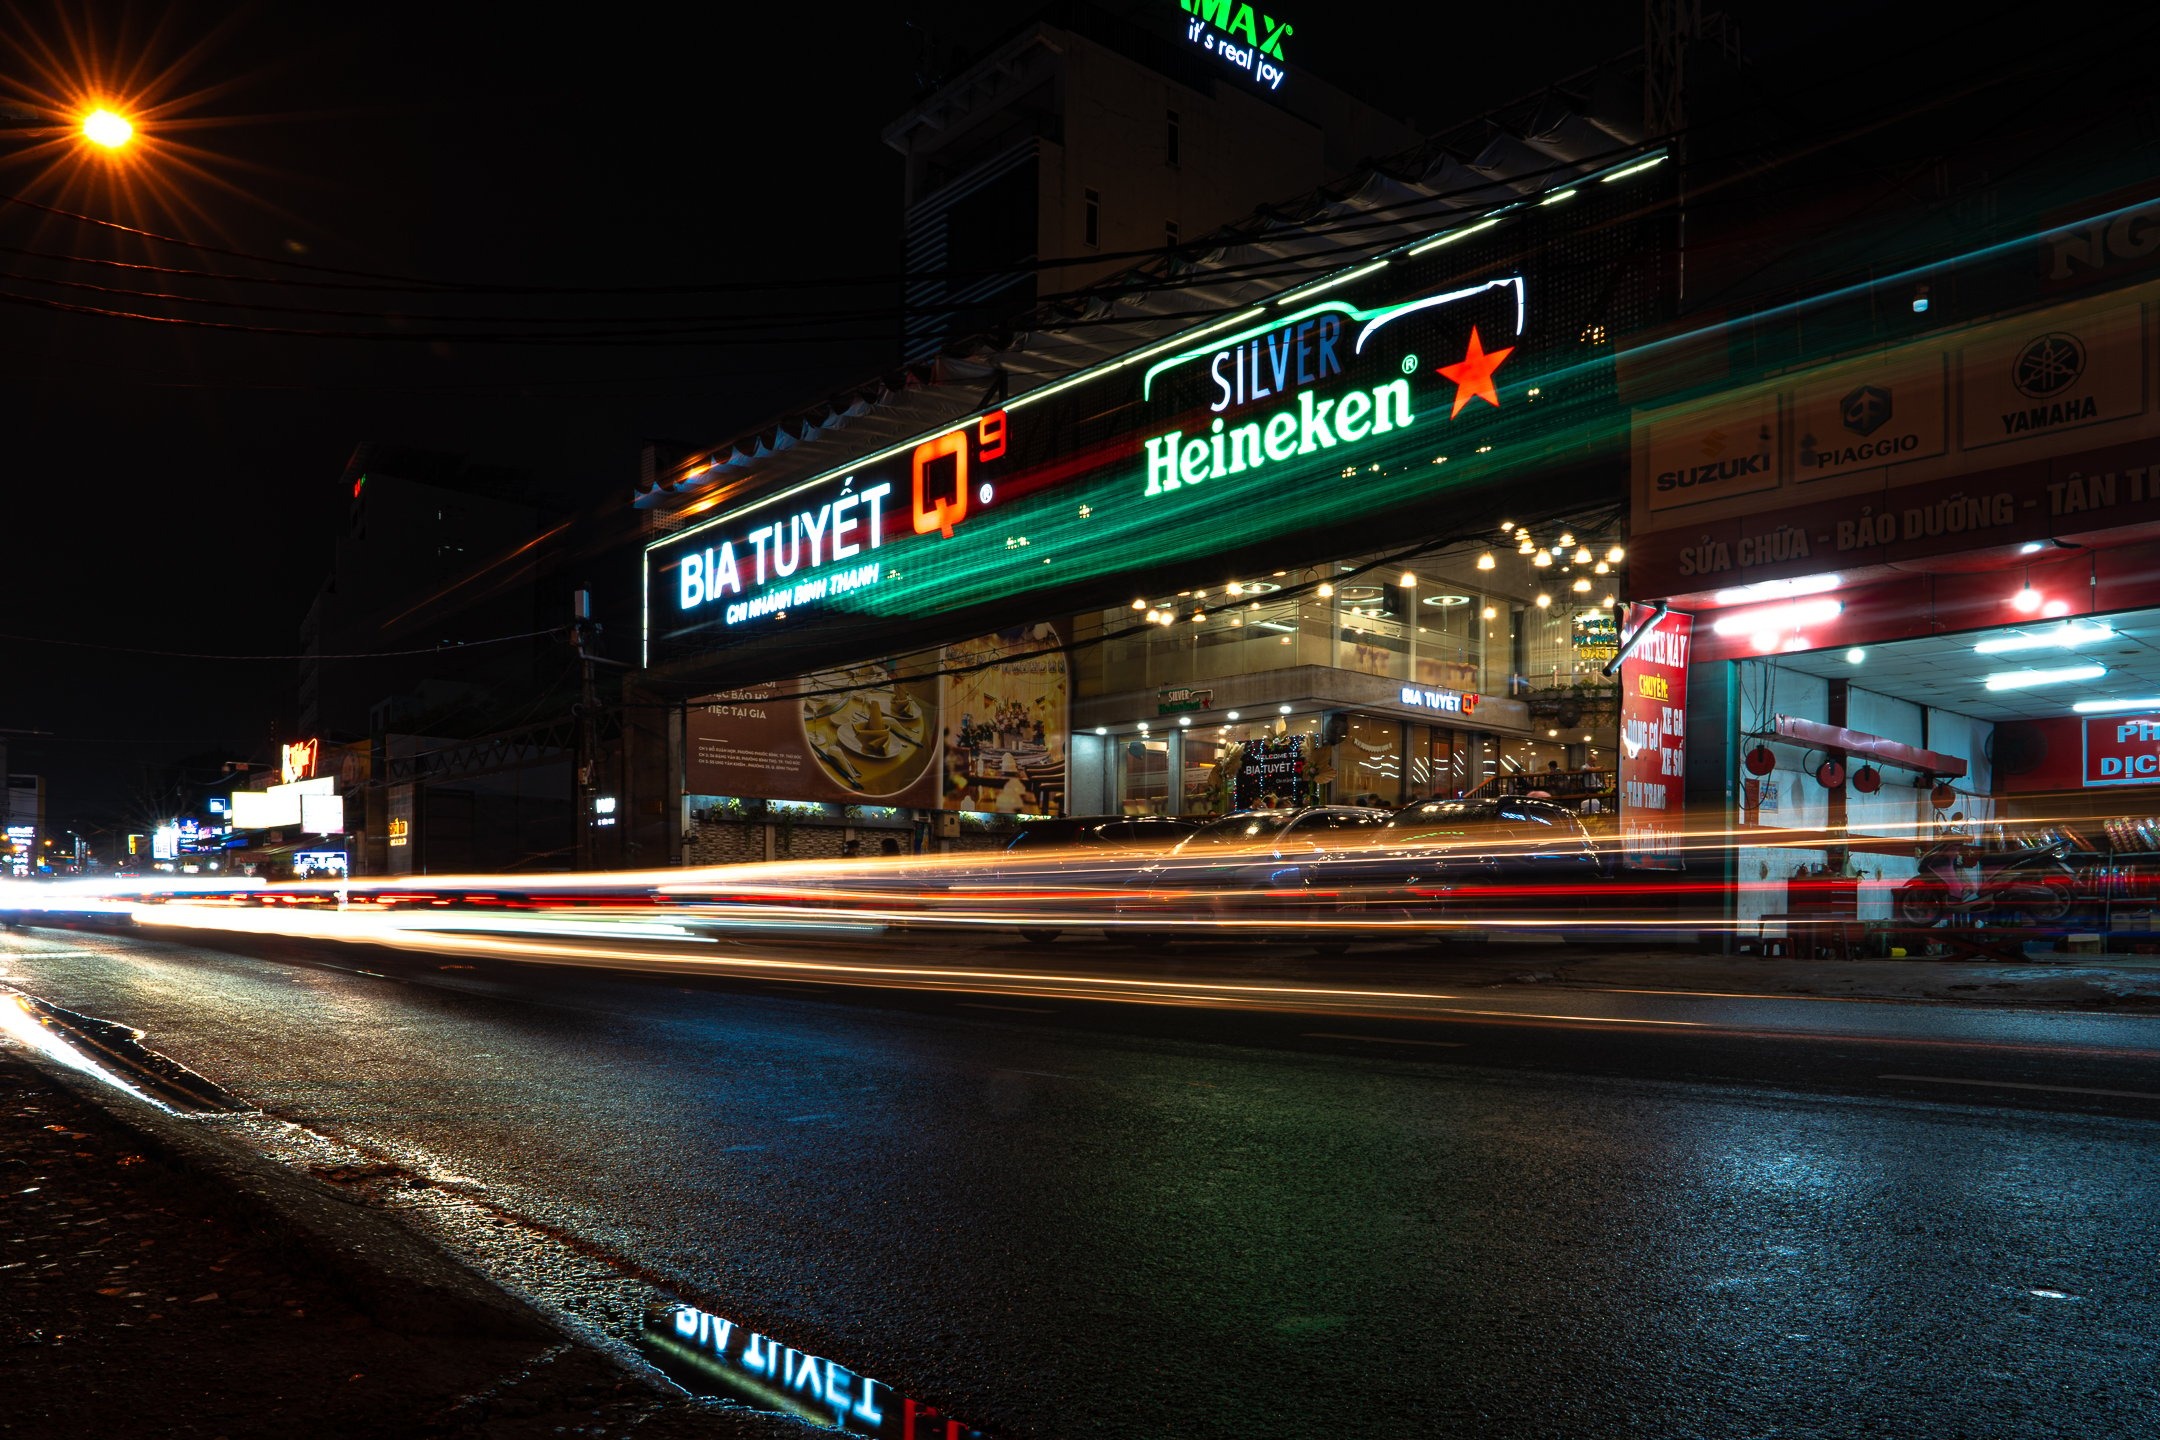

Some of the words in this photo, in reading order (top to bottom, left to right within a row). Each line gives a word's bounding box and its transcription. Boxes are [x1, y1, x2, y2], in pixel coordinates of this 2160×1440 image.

[1180, 0, 1287, 61] MAX
[1188, 17, 1215, 50] it's
[1218, 40, 1254, 70] real
[1256, 54, 1284, 90] joy
[1210, 313, 1341, 412] SILVER
[2002, 396, 2098, 436] YAMAHA
[1144, 377, 1414, 497] Heineken
[1817, 433, 1919, 469] PIAGGIO
[1656, 453, 1771, 492] SUZUKI
[680, 540, 741, 610] BIA
[748, 476, 891, 586] TUYẾT
[1679, 534, 1730, 577] SỬA
[1736, 524, 1811, 565] CHỮA
[1836, 506, 1897, 553] BẢO
[1904, 491, 2015, 541] DƯỠNG
[2046, 470, 2117, 517] TÂN
[726, 600, 748, 625] CHI
[748, 588, 793, 618] NHÁNH
[793, 578, 828, 606] BÌNH
[1666, 624, 1687, 668] MÁY
[749, 708, 767, 719] GIA
[1168, 689, 1190, 702] SILVER
[1401, 687, 1422, 706] BIA
[1662, 707, 1672, 735] XE
[1673, 709, 1684, 736] GA
[1245, 765, 1260, 775] BIA
[1661, 747, 1672, 775] XE
[2100, 754, 2160, 778] DỊC
